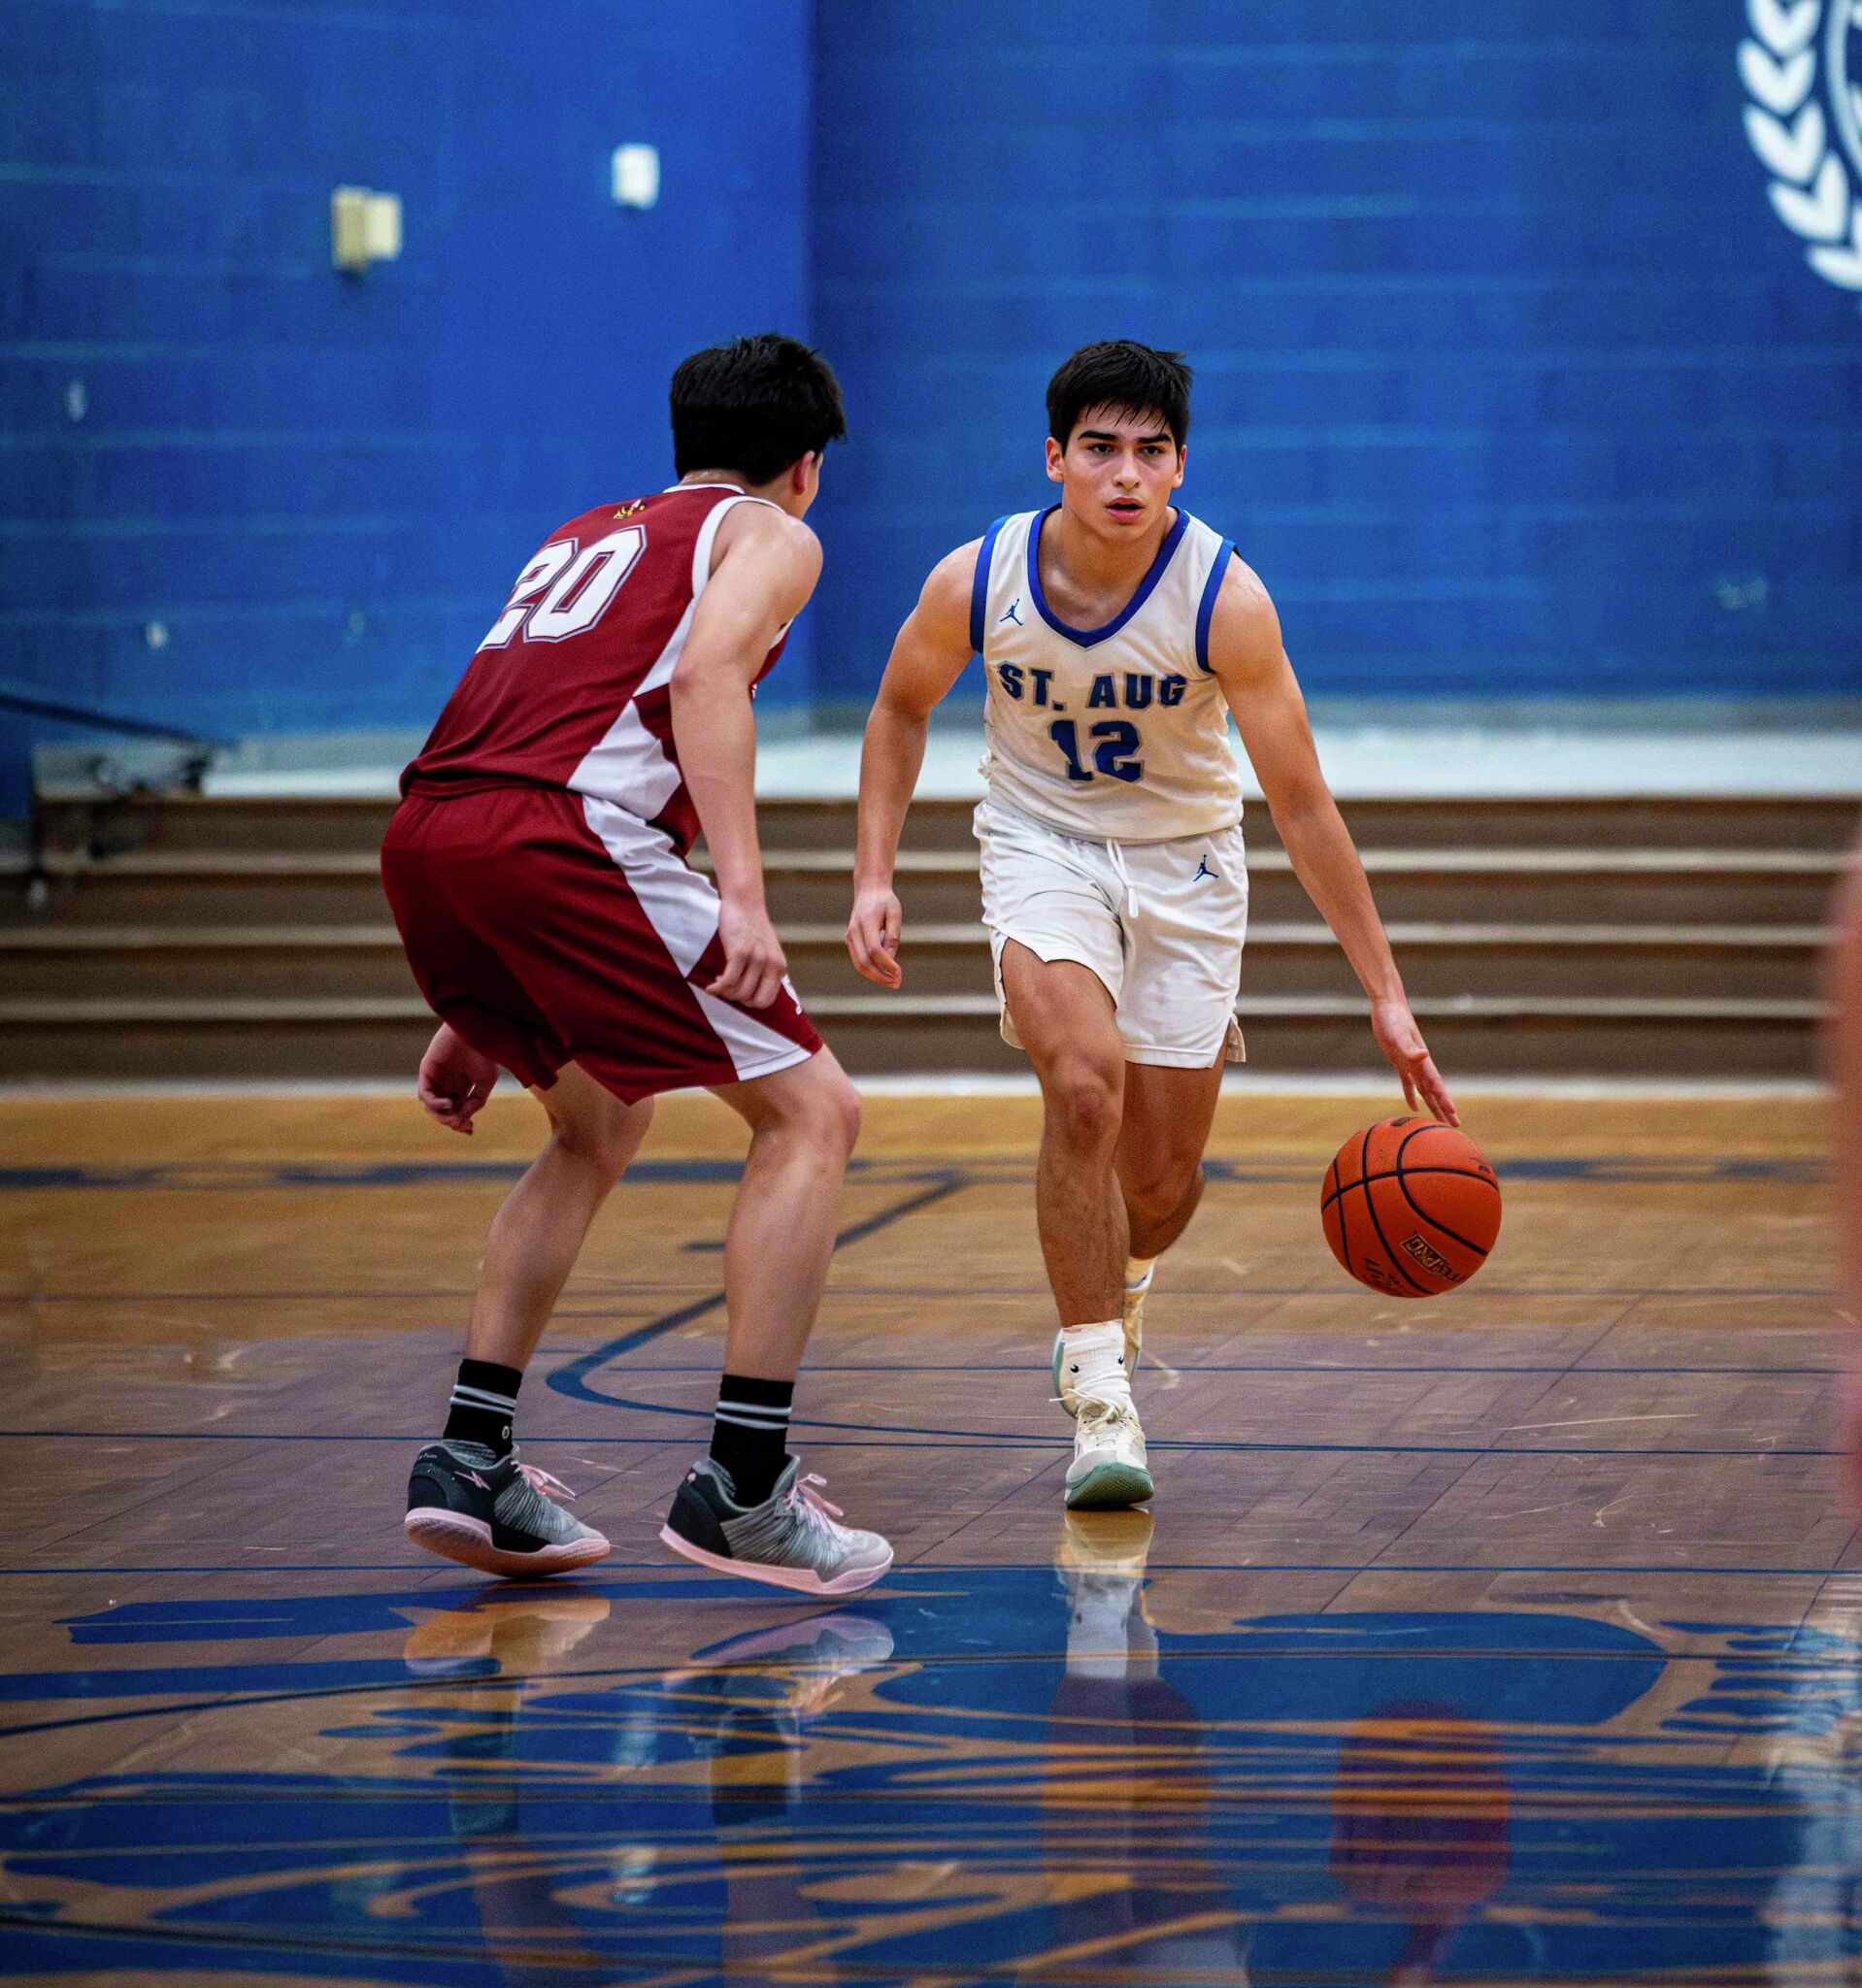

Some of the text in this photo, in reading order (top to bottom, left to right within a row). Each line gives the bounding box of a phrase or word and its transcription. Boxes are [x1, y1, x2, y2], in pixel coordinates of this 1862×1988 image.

[476, 524, 648, 653] 20
[996, 660, 1187, 711] ST. AUG
[1047, 718, 1145, 782] 12
